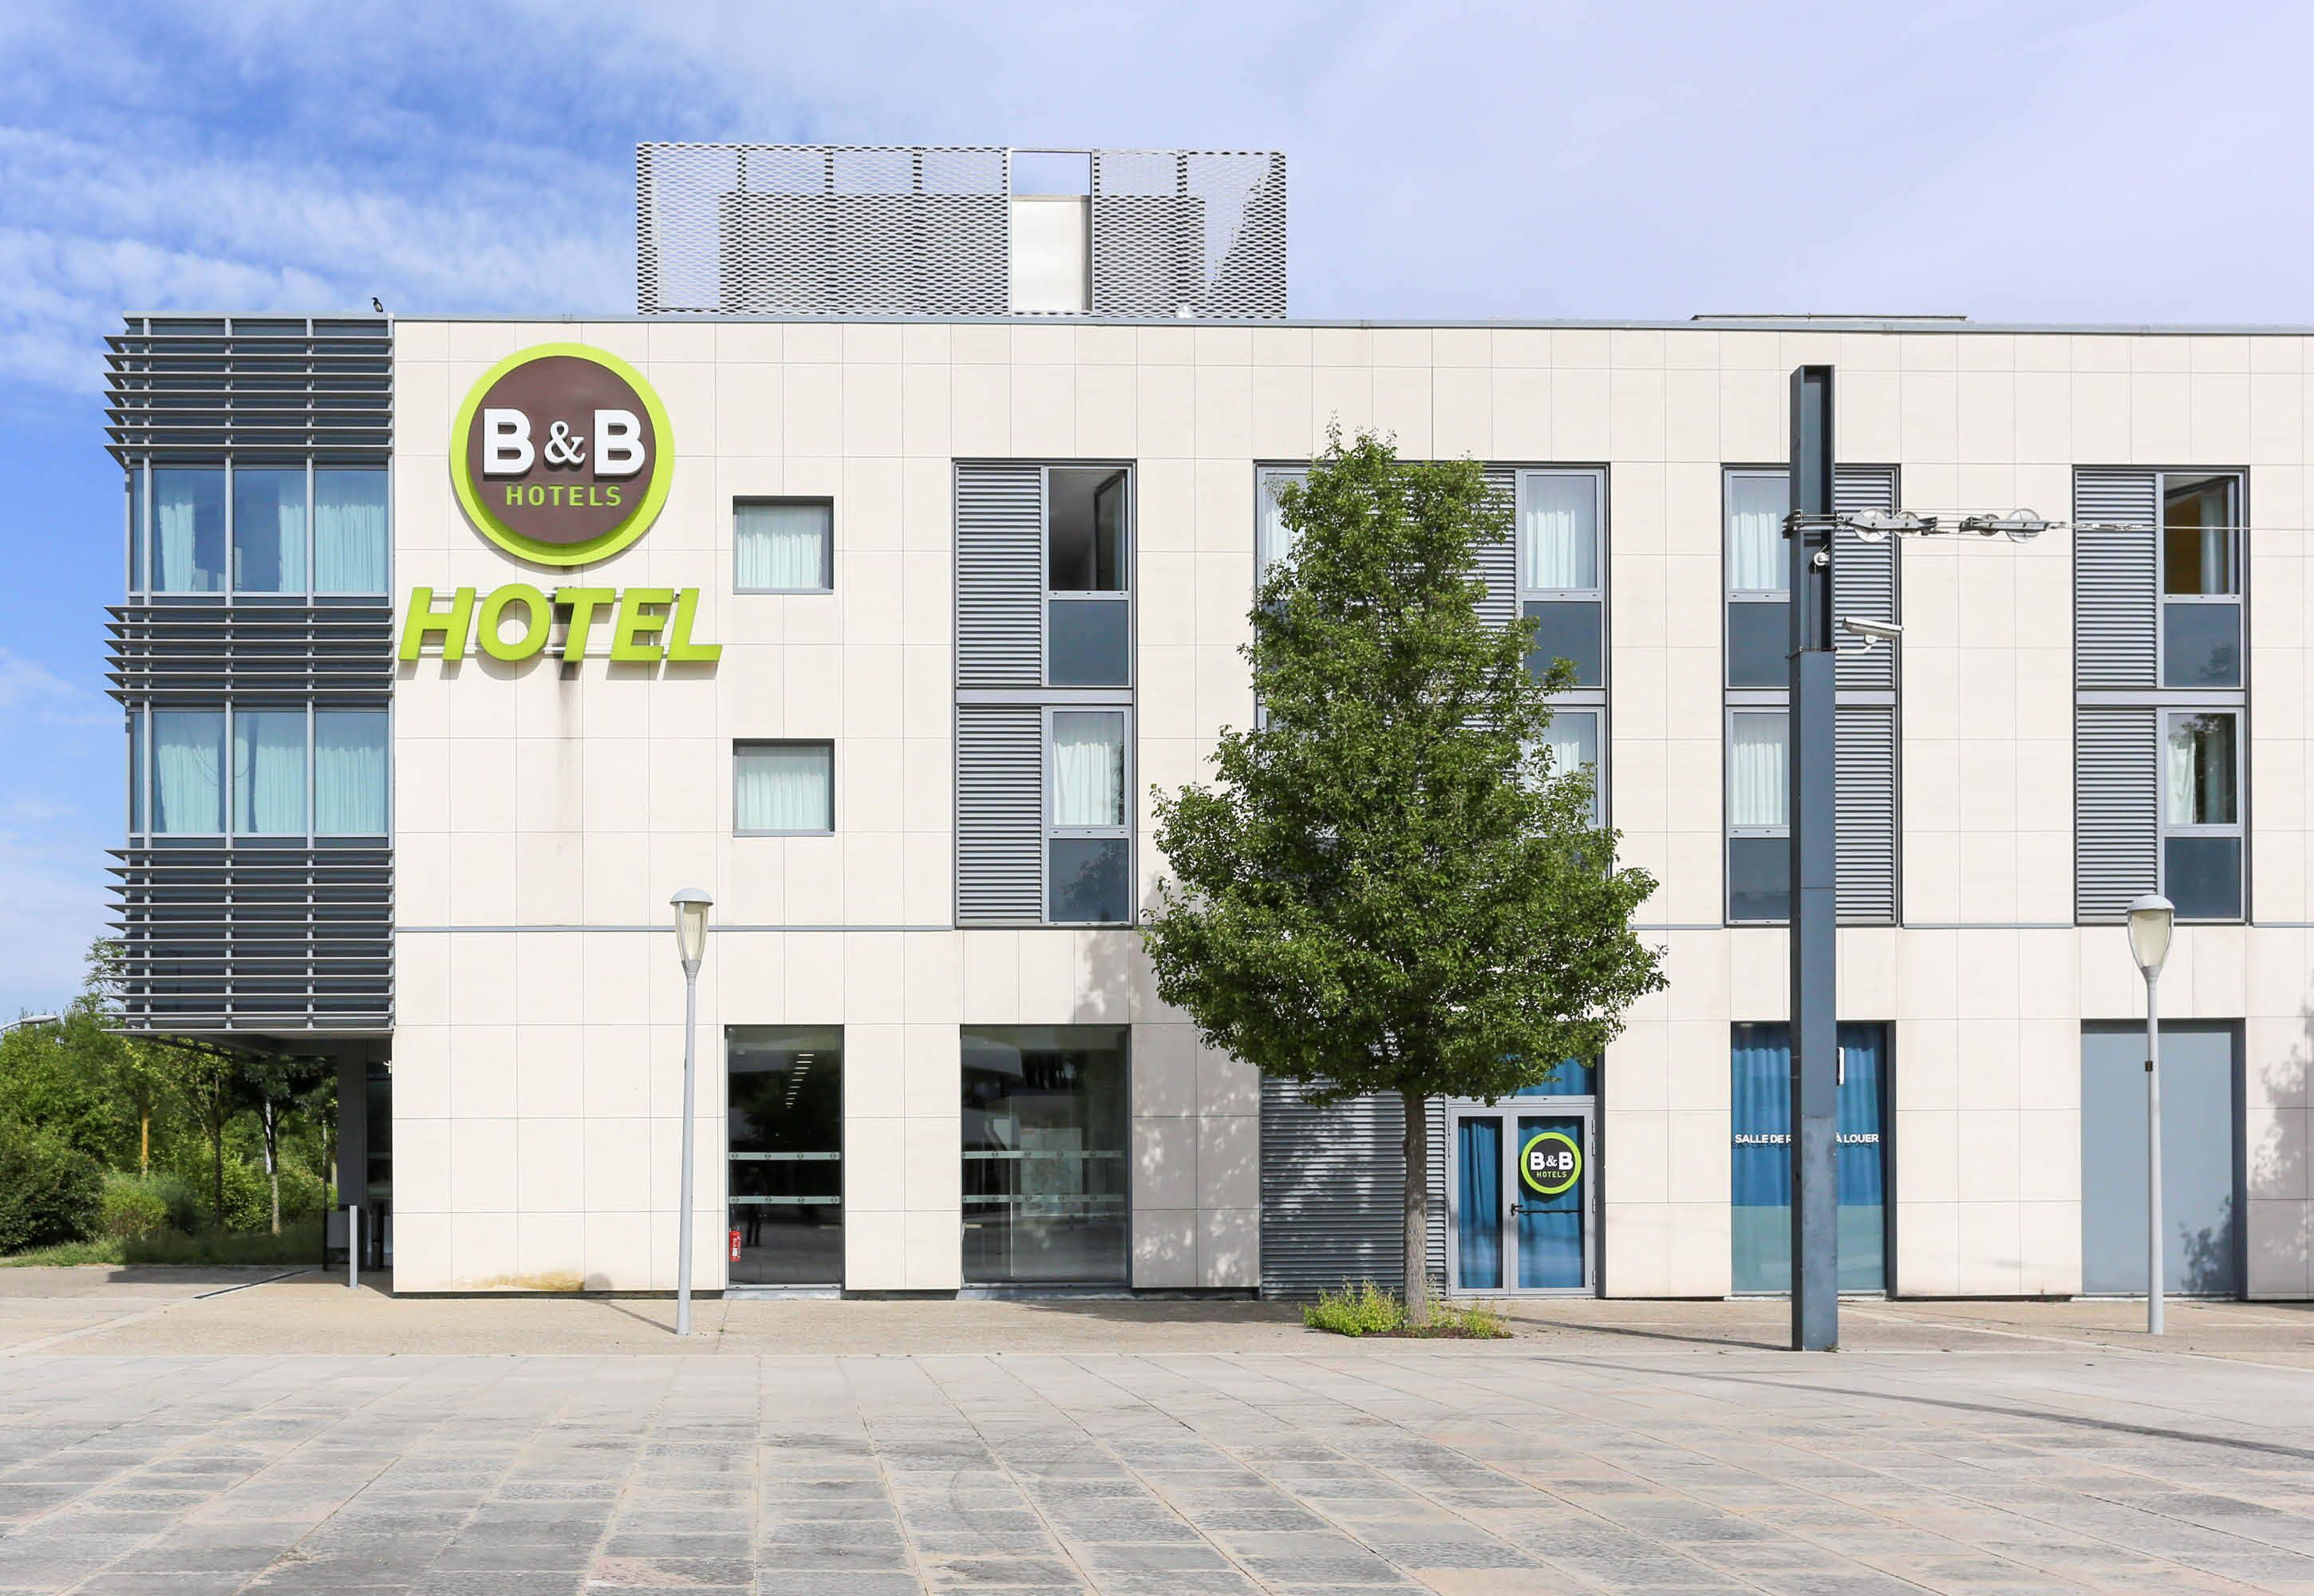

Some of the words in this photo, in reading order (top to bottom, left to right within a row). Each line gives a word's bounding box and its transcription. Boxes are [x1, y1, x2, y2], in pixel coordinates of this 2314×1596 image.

[483, 408, 646, 476] B&B
[505, 484, 622, 507] HOTELS
[398, 583, 723, 662] HOTEL
[1735, 1134, 1768, 1144] SALLE
[1770, 1134, 1785, 1144] DE
[1844, 1133, 1879, 1143] LOUER
[1530, 1152, 1574, 1170] B&B
